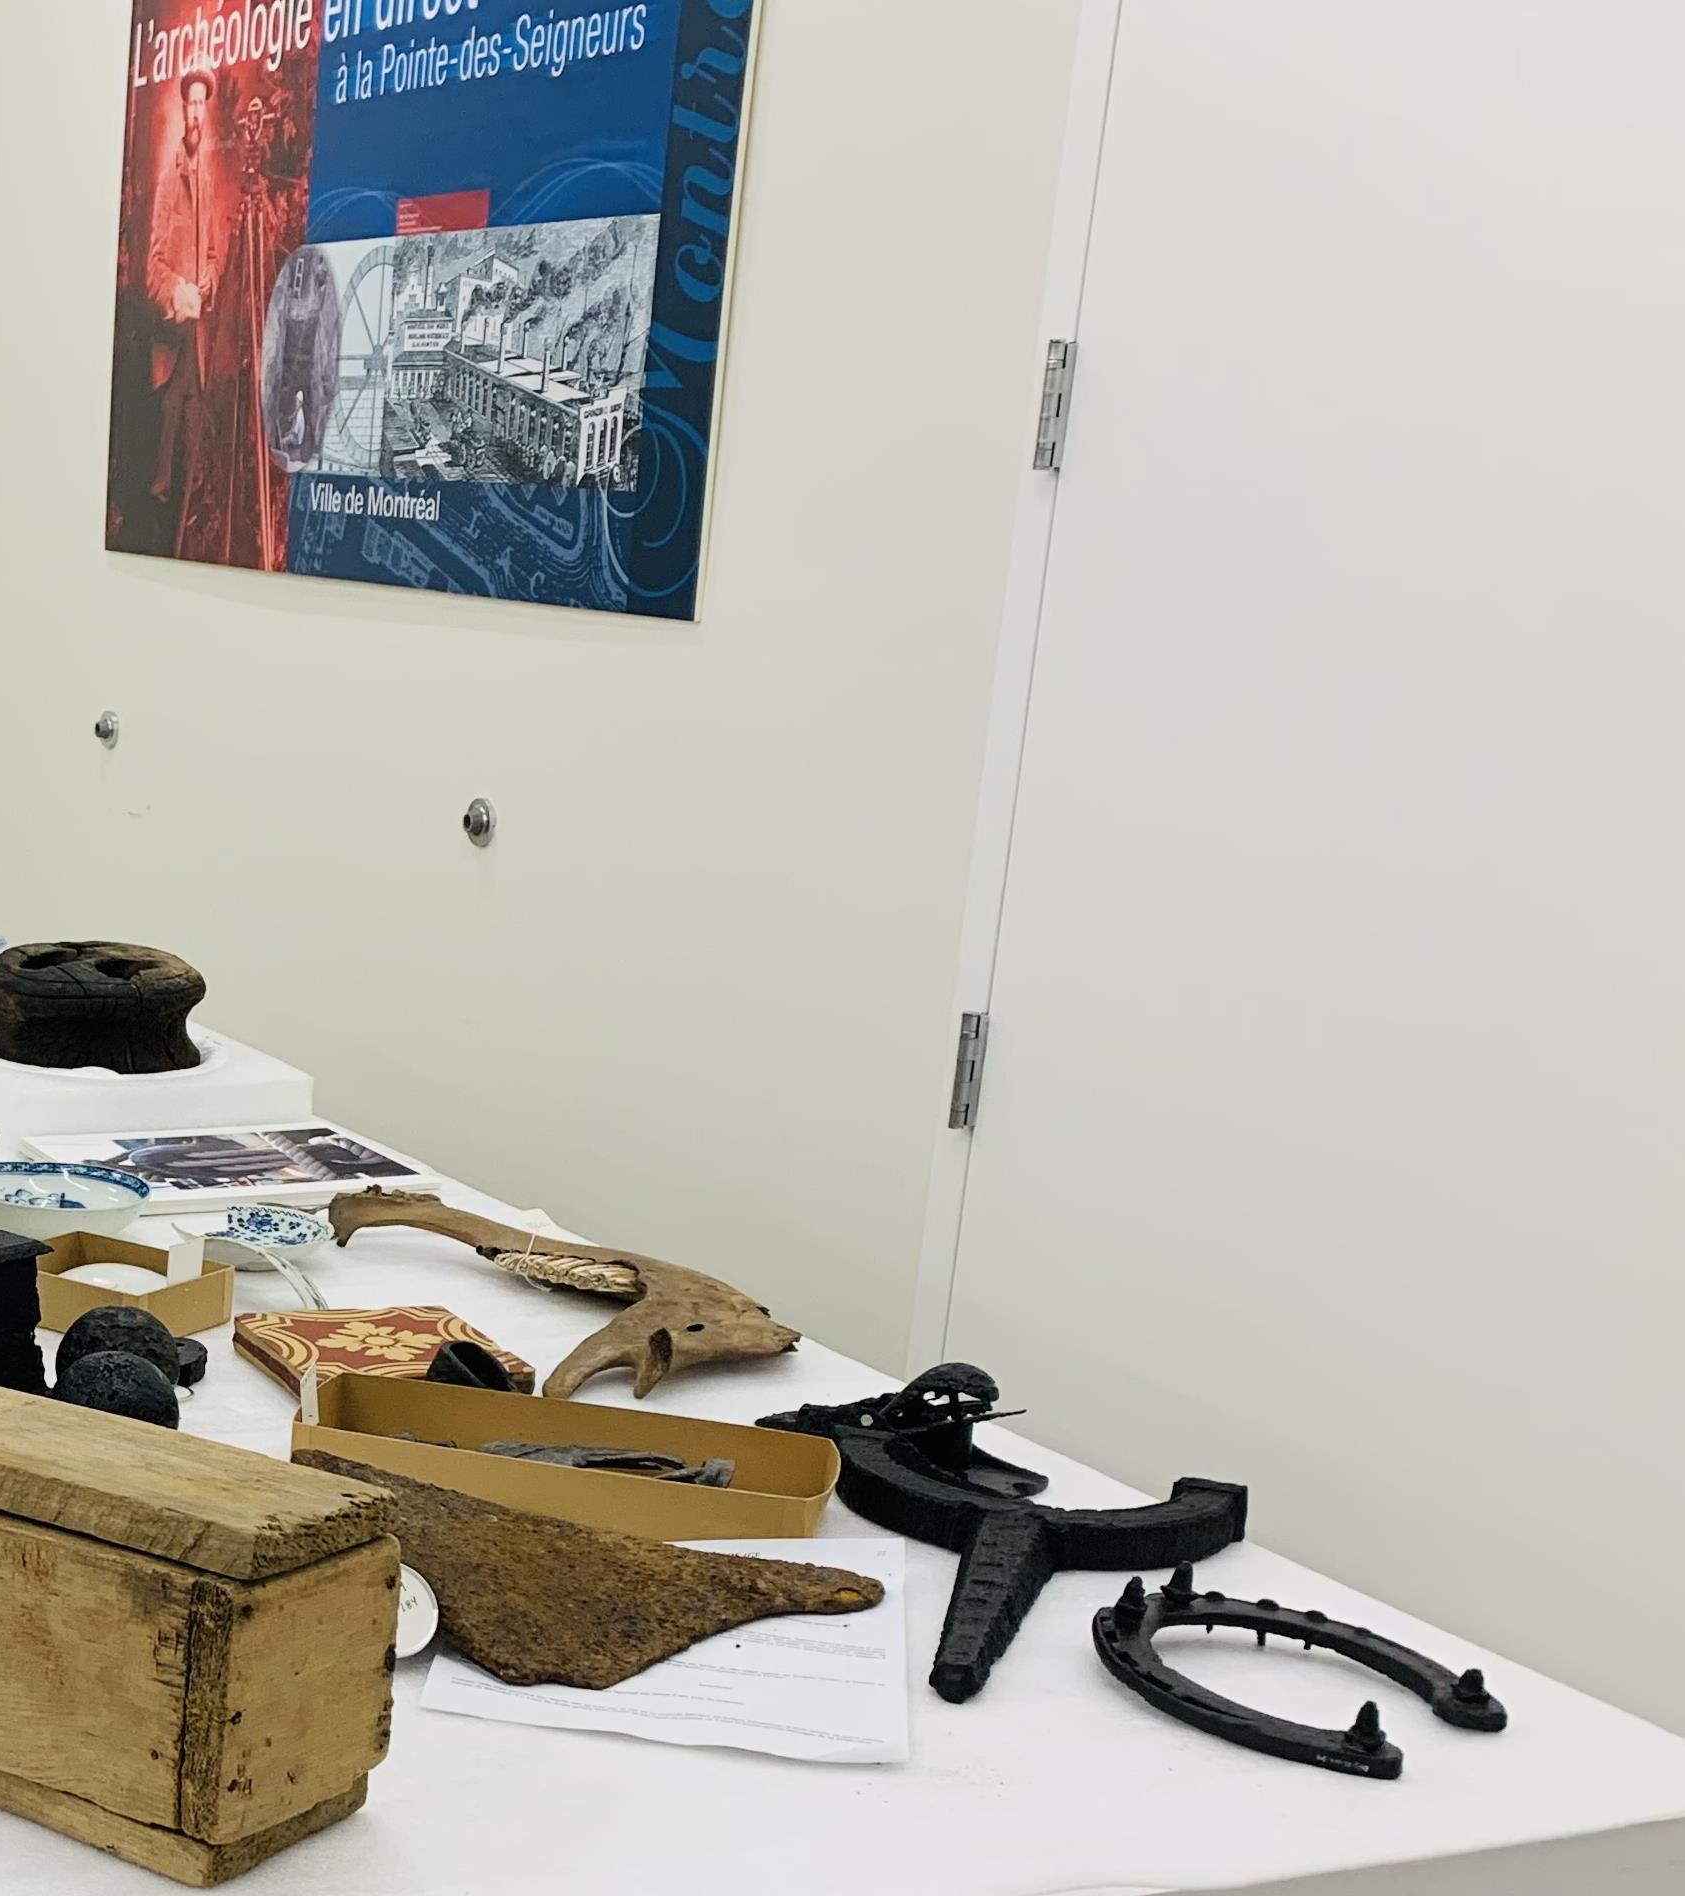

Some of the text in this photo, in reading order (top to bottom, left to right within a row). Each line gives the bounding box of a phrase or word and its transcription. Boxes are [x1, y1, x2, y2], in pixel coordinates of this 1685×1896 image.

[132, 0, 313, 88] L'archéologie
[335, 3, 648, 104] à la Pointe-des-Seigneurs
[310, 482, 441, 522] Ville de Montréal
